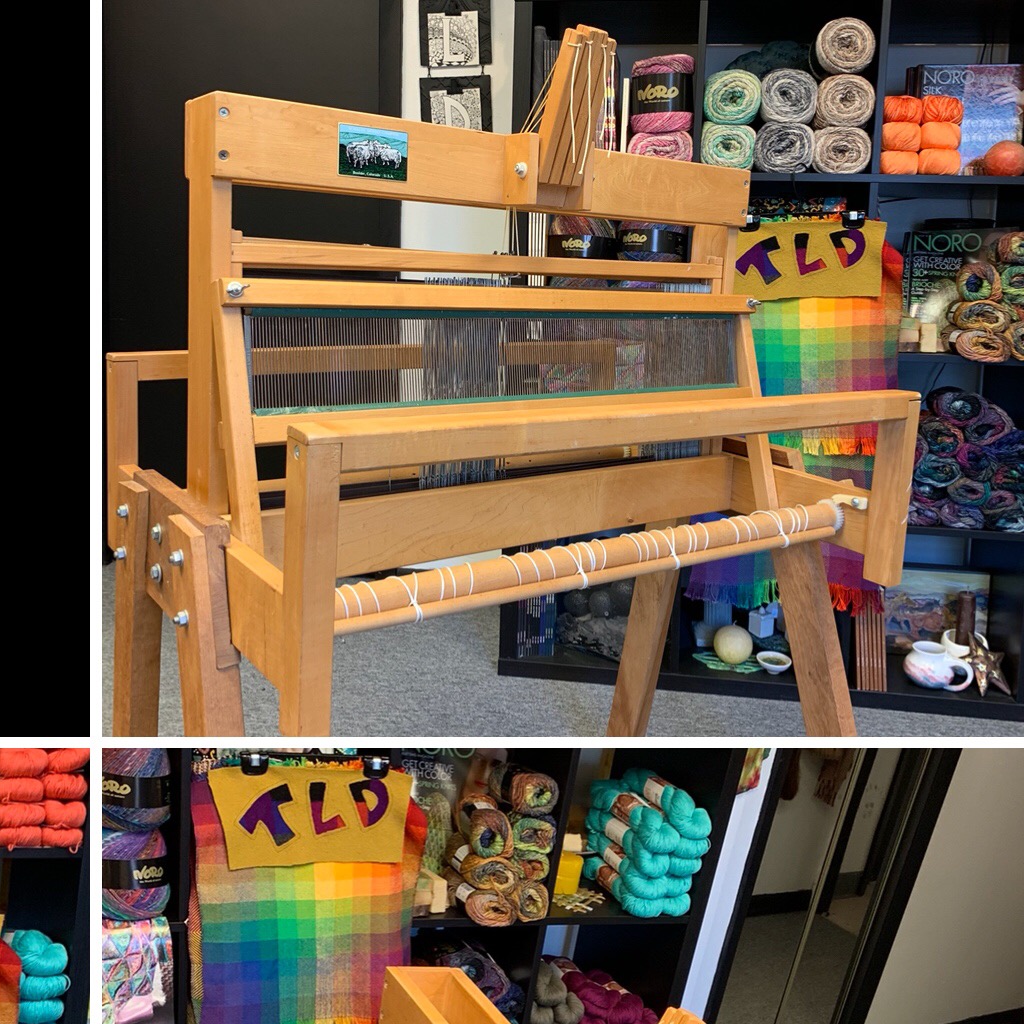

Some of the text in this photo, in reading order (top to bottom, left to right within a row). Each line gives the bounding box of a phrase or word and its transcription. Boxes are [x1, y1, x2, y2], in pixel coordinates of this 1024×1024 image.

[924, 70, 976, 85] NORO
[638, 84, 680, 101] NORO
[923, 86, 943, 95] SILK
[562, 238, 592, 249] NORO
[623, 233, 648, 243] NORO
[914, 233, 982, 253] NORO
[734, 229, 867, 286] TLD
[930, 257, 963, 265] CREATIVE
[934, 262, 961, 270] COLOR
[402, 759, 455, 774] GET CREATIVE
[424, 769, 453, 782] COLOR
[102, 777, 132, 795] ORO
[238, 778, 390, 847] TLD
[133, 866, 164, 881] NORO
